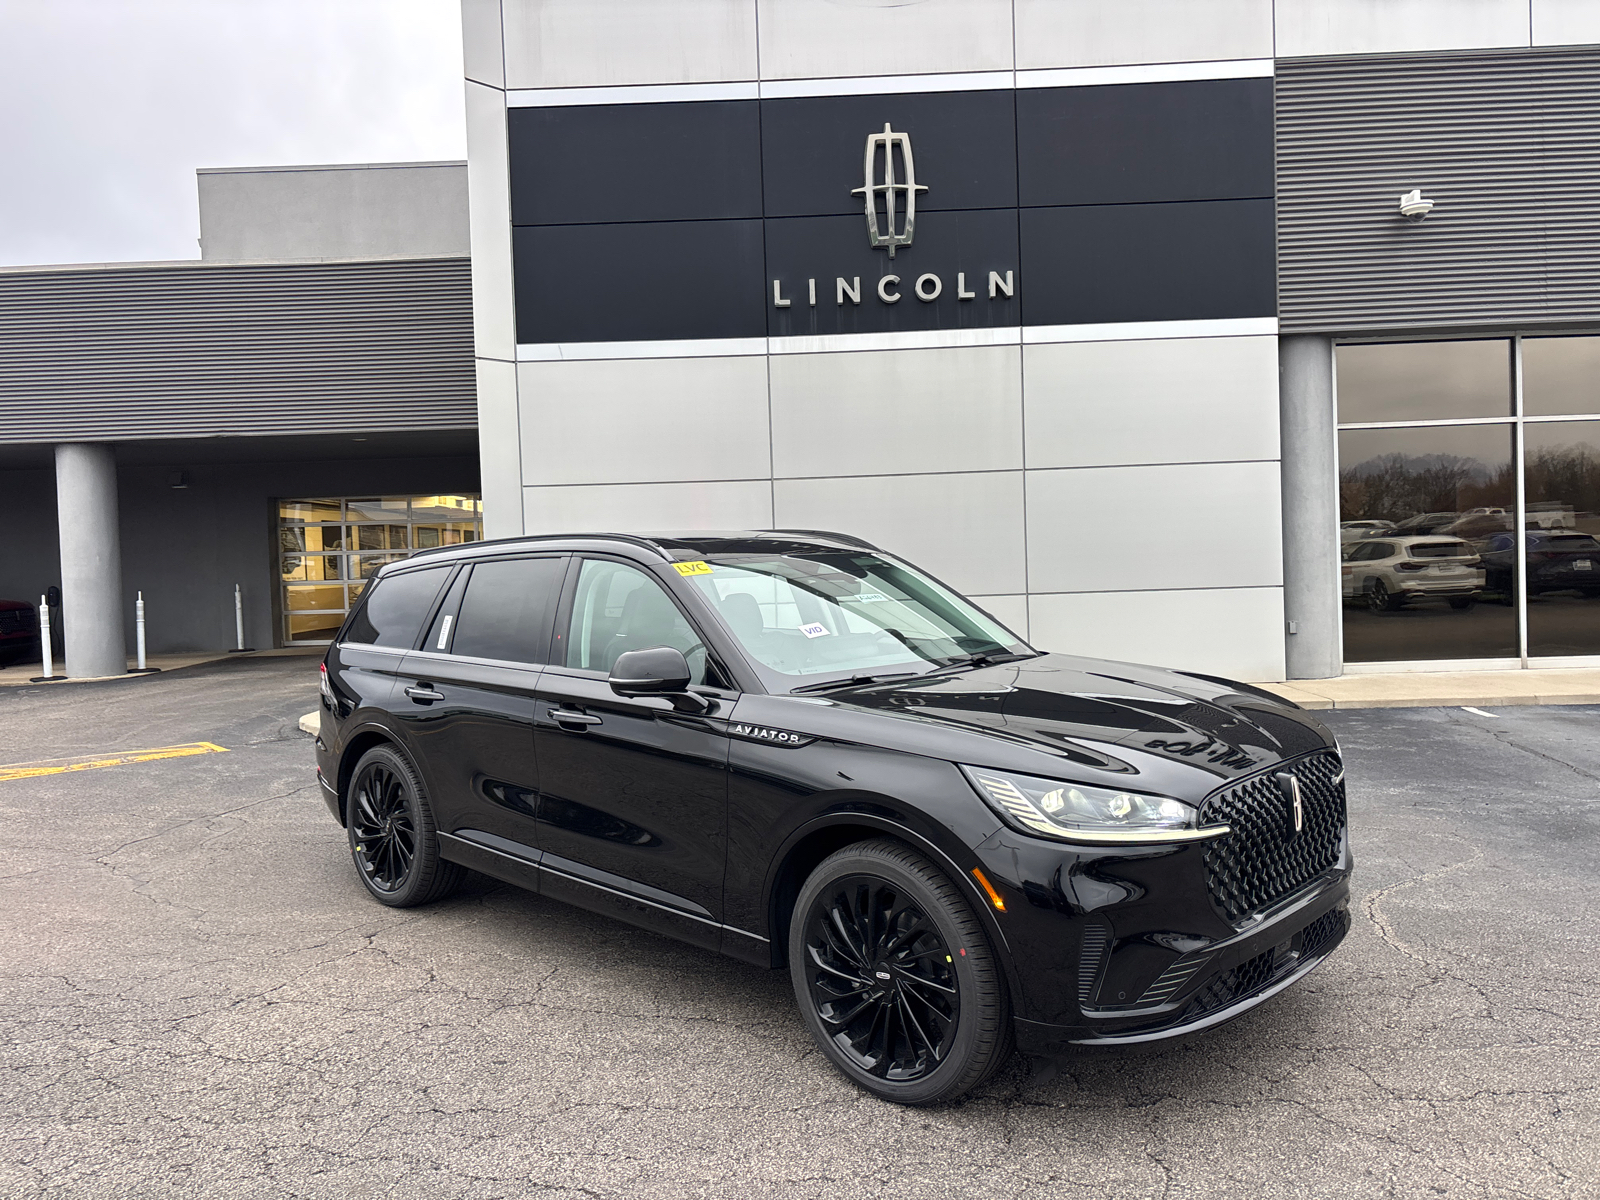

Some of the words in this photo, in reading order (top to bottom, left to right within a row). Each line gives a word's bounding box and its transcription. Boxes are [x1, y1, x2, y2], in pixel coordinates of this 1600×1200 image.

[773, 270, 1014, 308] LINCOLN
[676, 564, 708, 574] LVC
[804, 626, 823, 635] VID
[735, 724, 799, 743] AVIATOR
